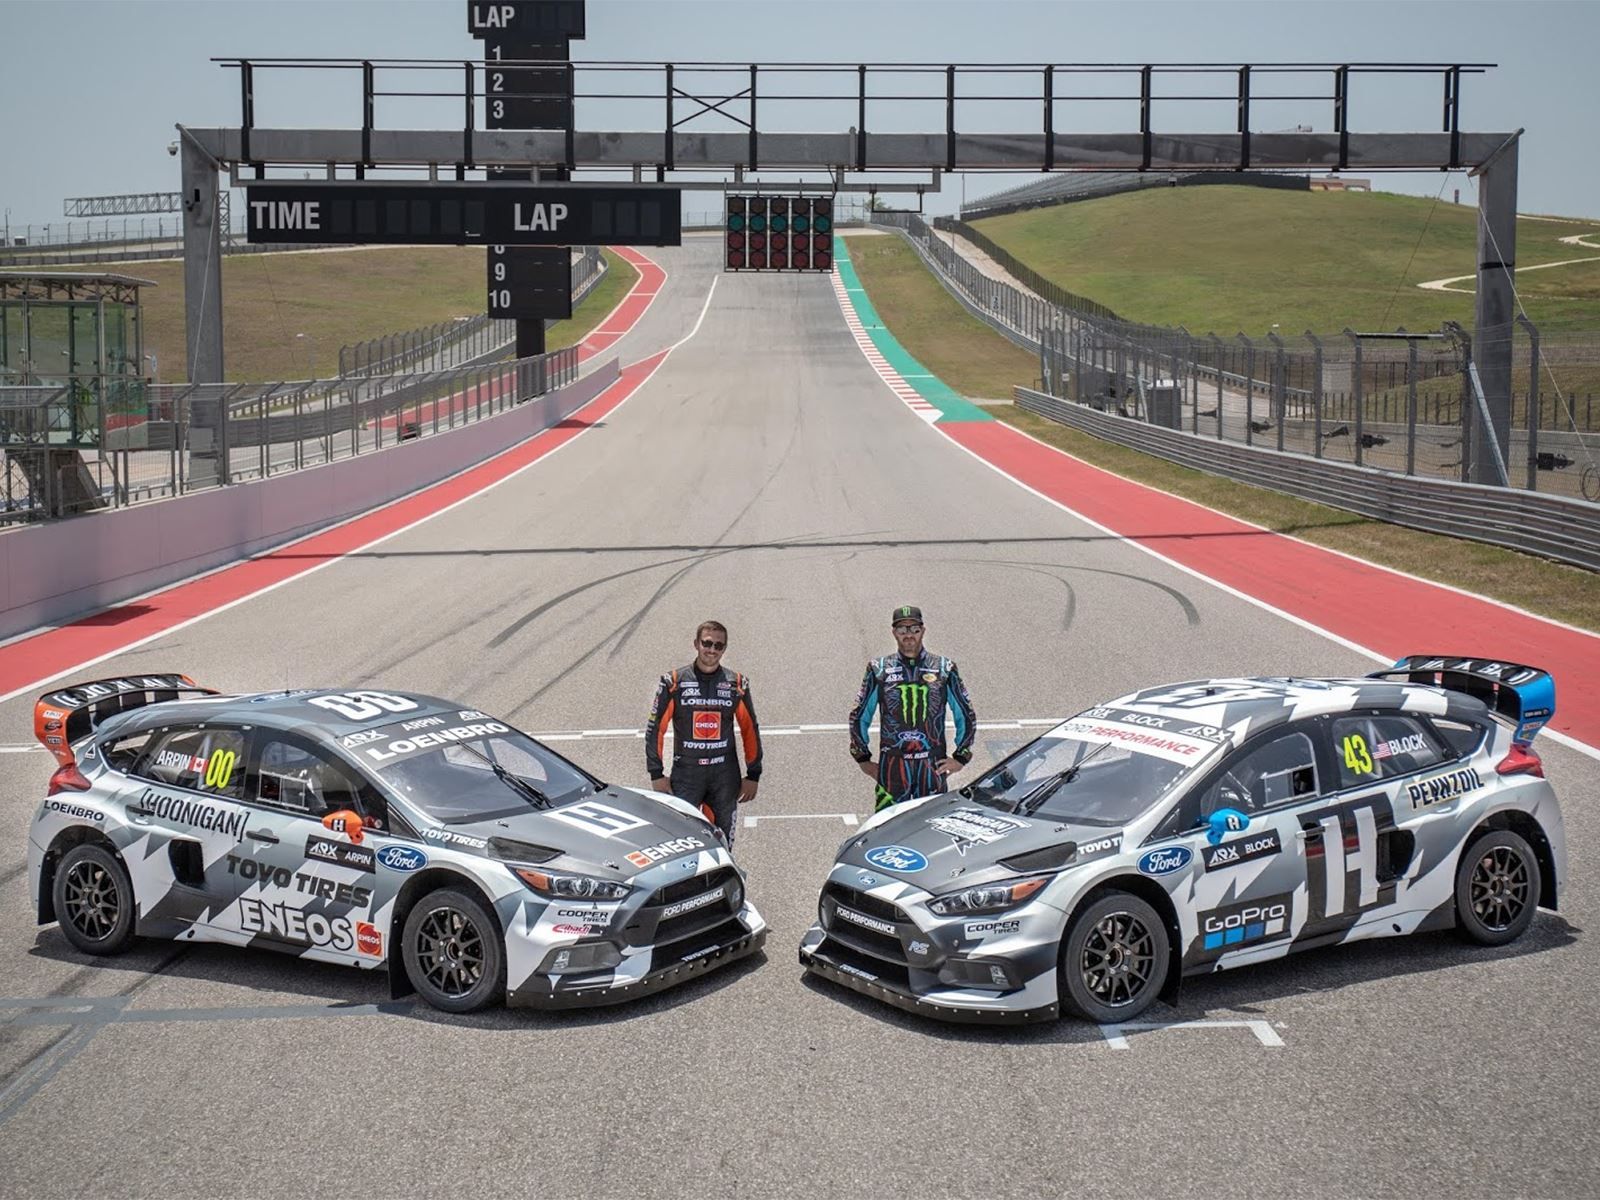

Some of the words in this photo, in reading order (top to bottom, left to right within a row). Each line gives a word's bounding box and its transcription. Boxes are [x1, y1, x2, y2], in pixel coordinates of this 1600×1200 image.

[473, 5, 515, 28] LAP
[492, 45, 501, 64] 1
[492, 73, 504, 91] 2
[493, 100, 504, 119] 3
[250, 201, 321, 230] TIME
[514, 203, 568, 231] LAP
[494, 262, 506, 281] 9
[489, 290, 511, 308] 10
[681, 699, 733, 707] LOENBRO
[401, 716, 445, 732] ARPIN
[1121, 713, 1172, 728] BLOCK
[365, 722, 510, 762] LOENBRO
[683, 741, 705, 749] TOYO
[706, 740, 728, 749] TIRES
[1091, 727, 1201, 756] PERFORMANCE
[1389, 733, 1427, 756] BLOCK
[156, 749, 192, 770] ARPIN
[1343, 734, 1373, 775] 43
[205, 748, 236, 789] 00
[1408, 768, 1485, 809] PENNZOIL
[43, 799, 105, 823] LOENBRO
[421, 827, 452, 843] TOYO
[453, 834, 488, 849] TIRES
[645, 836, 705, 861] ENEOS
[1077, 839, 1112, 855] TOYO
[1245, 837, 1275, 854] BLOCK
[344, 850, 371, 865] ARPIN
[383, 847, 418, 869] Ford
[870, 847, 919, 870] Ford
[1148, 849, 1183, 872] Ford
[226, 855, 294, 889] TOYO
[296, 872, 373, 909] TIRES
[557, 909, 609, 918] COOPER
[664, 904, 681, 917] FORD
[681, 888, 724, 912] PERFORMANCE
[239, 897, 354, 951] ENEOS
[836, 906, 850, 920] FORD
[850, 911, 896, 935] PERFORMANCE
[966, 920, 1020, 932] COOPER
[1205, 904, 1286, 933] GoPro
[358, 932, 381, 946] ENEOS
[993, 927, 1020, 935] TIRES
[909, 940, 930, 956] RS
